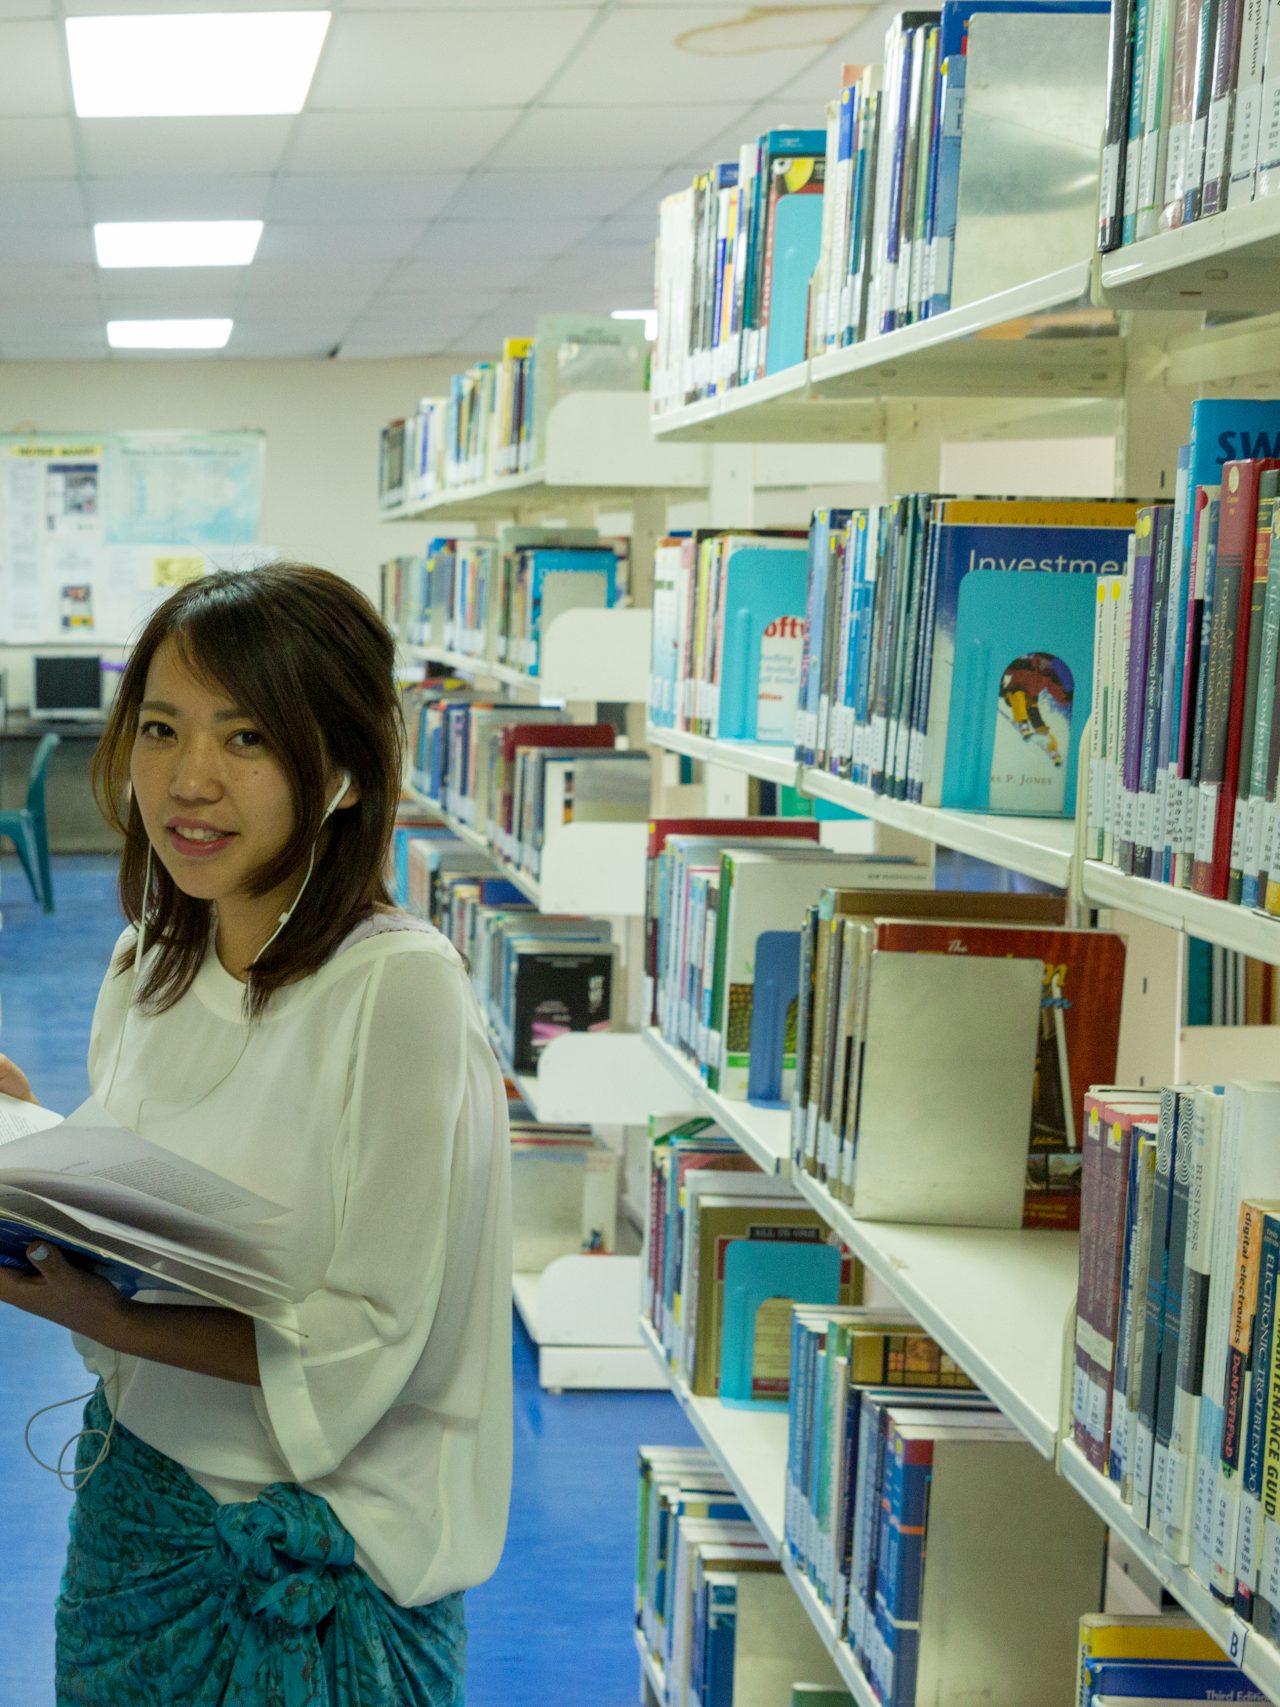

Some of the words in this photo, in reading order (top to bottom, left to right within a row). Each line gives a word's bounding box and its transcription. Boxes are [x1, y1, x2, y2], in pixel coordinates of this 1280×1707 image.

[1136, 6, 1146, 50] REAL
[1217, 0, 1229, 67] ommercial
[1249, 0, 1262, 76] pplications
[1131, 56, 1143, 117] ESTATE
[1148, 600, 1161, 676] Transcending
[1144, 708, 1154, 743] Public
[1147, 680, 1156, 704] New
[1190, 1163, 1203, 1251] BUSINESS
[1238, 1211, 1252, 1259] digital
[1231, 1264, 1249, 1344] electronics
[1257, 1253, 1275, 1360] ELECTRONIC
